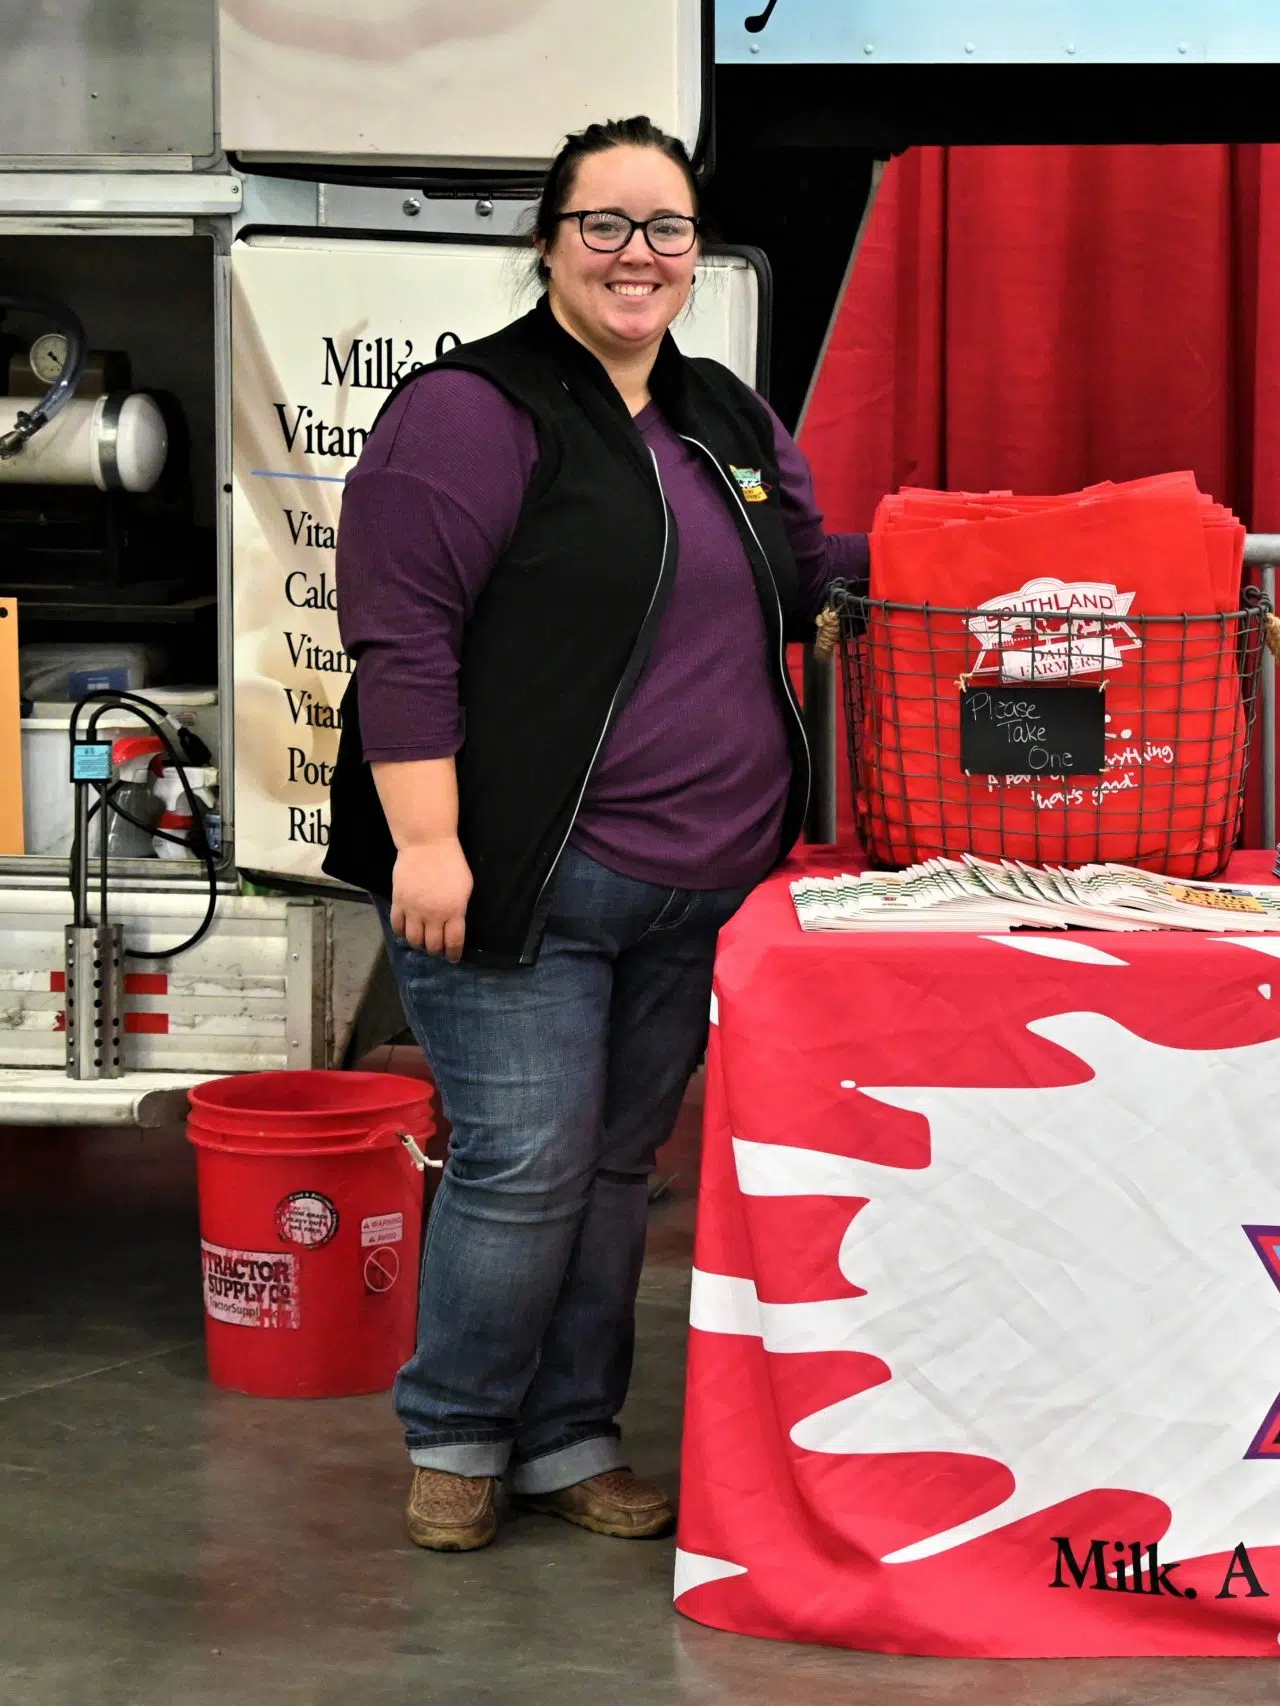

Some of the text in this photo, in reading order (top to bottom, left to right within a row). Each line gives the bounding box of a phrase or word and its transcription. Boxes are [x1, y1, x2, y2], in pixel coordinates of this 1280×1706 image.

[966, 692, 1041, 720] Please
[997, 718, 1047, 743] Take
[1028, 745, 1074, 770] One
[207, 1251, 290, 1284] TRACTOR
[208, 1274, 267, 1303] SUPPLY
[1049, 1537, 1197, 1600] Milk.
[1215, 1541, 1265, 1599] A
